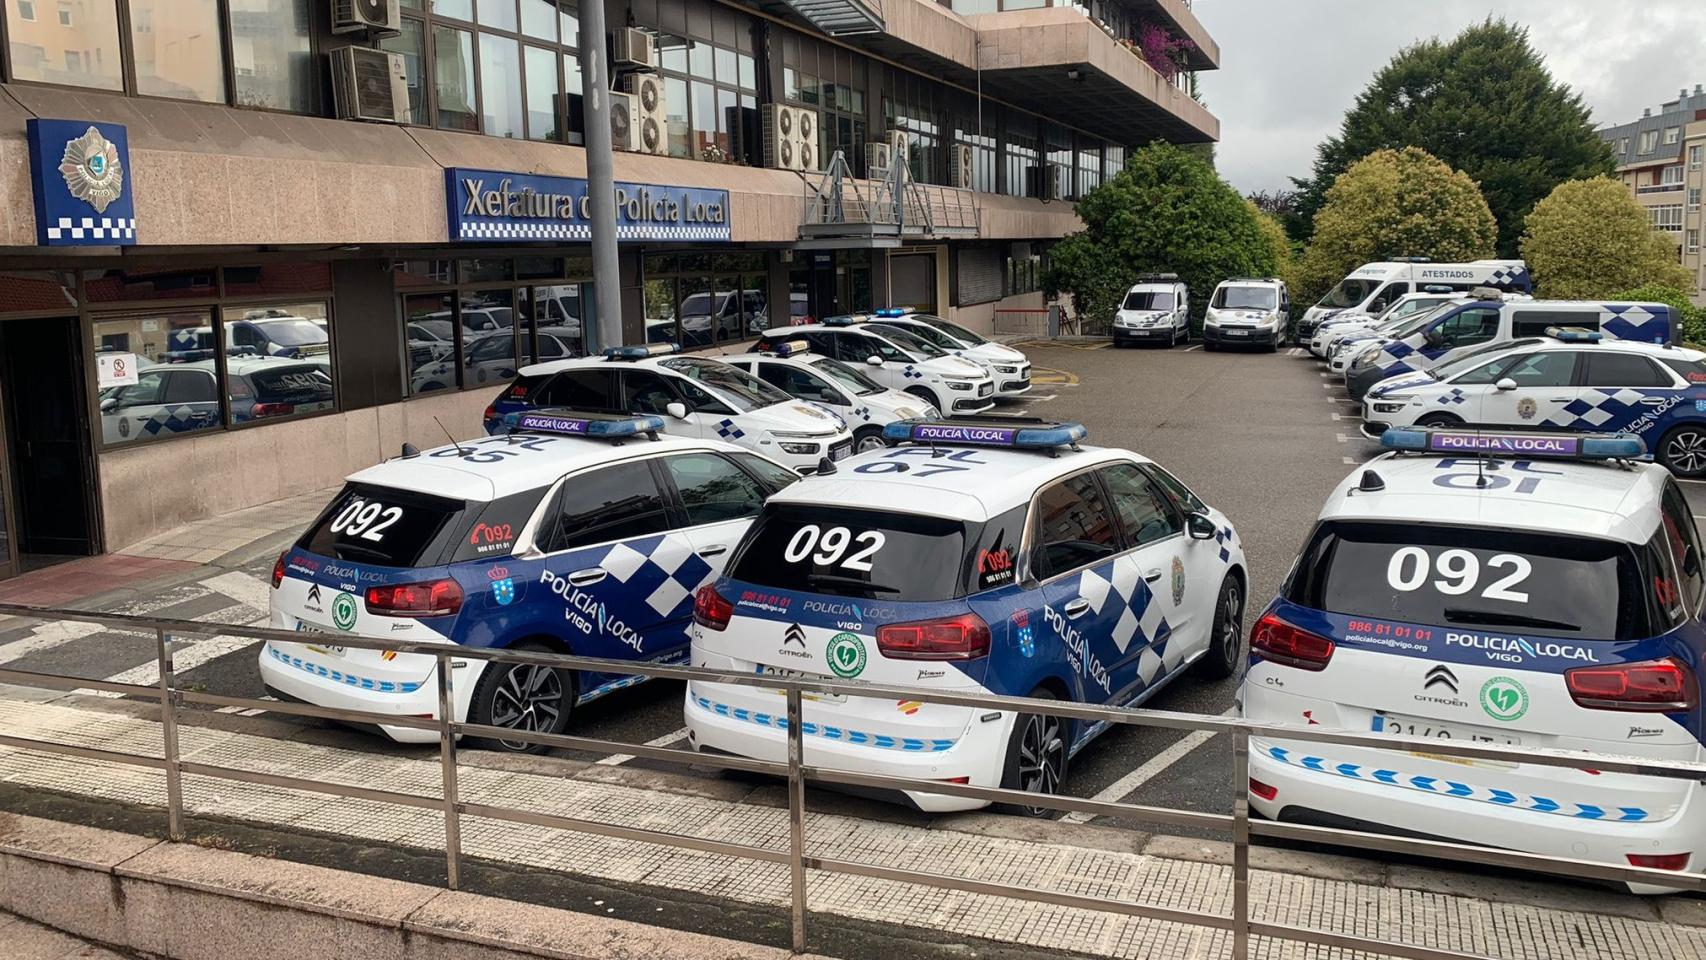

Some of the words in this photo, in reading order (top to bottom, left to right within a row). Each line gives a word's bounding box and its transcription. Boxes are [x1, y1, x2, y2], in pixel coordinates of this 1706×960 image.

[462, 177, 574, 219] Xefatura
[614, 186, 679, 222] Policía
[684, 192, 724, 223] Local
[1422, 270, 1474, 279] ATESTADOS
[1652, 394, 1685, 416] LOCAL
[557, 422, 580, 431] LOCAL
[970, 430, 1005, 441] LOCAL
[1514, 439, 1565, 450] LOCAL
[330, 501, 403, 542] 092
[484, 523, 513, 543] 092
[784, 524, 886, 572] 092
[987, 549, 1012, 571] 092
[360, 571, 388, 583] LOCAL
[1387, 546, 1532, 603] 092
[340, 582, 356, 592] VIGO
[540, 569, 598, 619] POLICÍA
[606, 615, 643, 653] LOCAL
[803, 601, 851, 615] POLICÍA
[565, 608, 592, 634] VIGO
[837, 621, 862, 630] VIGO
[1348, 620, 1372, 633] 986
[1375, 623, 1391, 635] 81
[1395, 626, 1411, 638] 01
[1415, 629, 1432, 640] 01
[1044, 604, 1084, 660] POLICÍA
[1088, 653, 1111, 695] LOCAL
[1345, 634, 1428, 652] policialocal@vigo.org
[1446, 633, 1522, 652] POLICIA
[1536, 643, 1599, 662] LOCAL
[1486, 651, 1522, 663] VIGO
